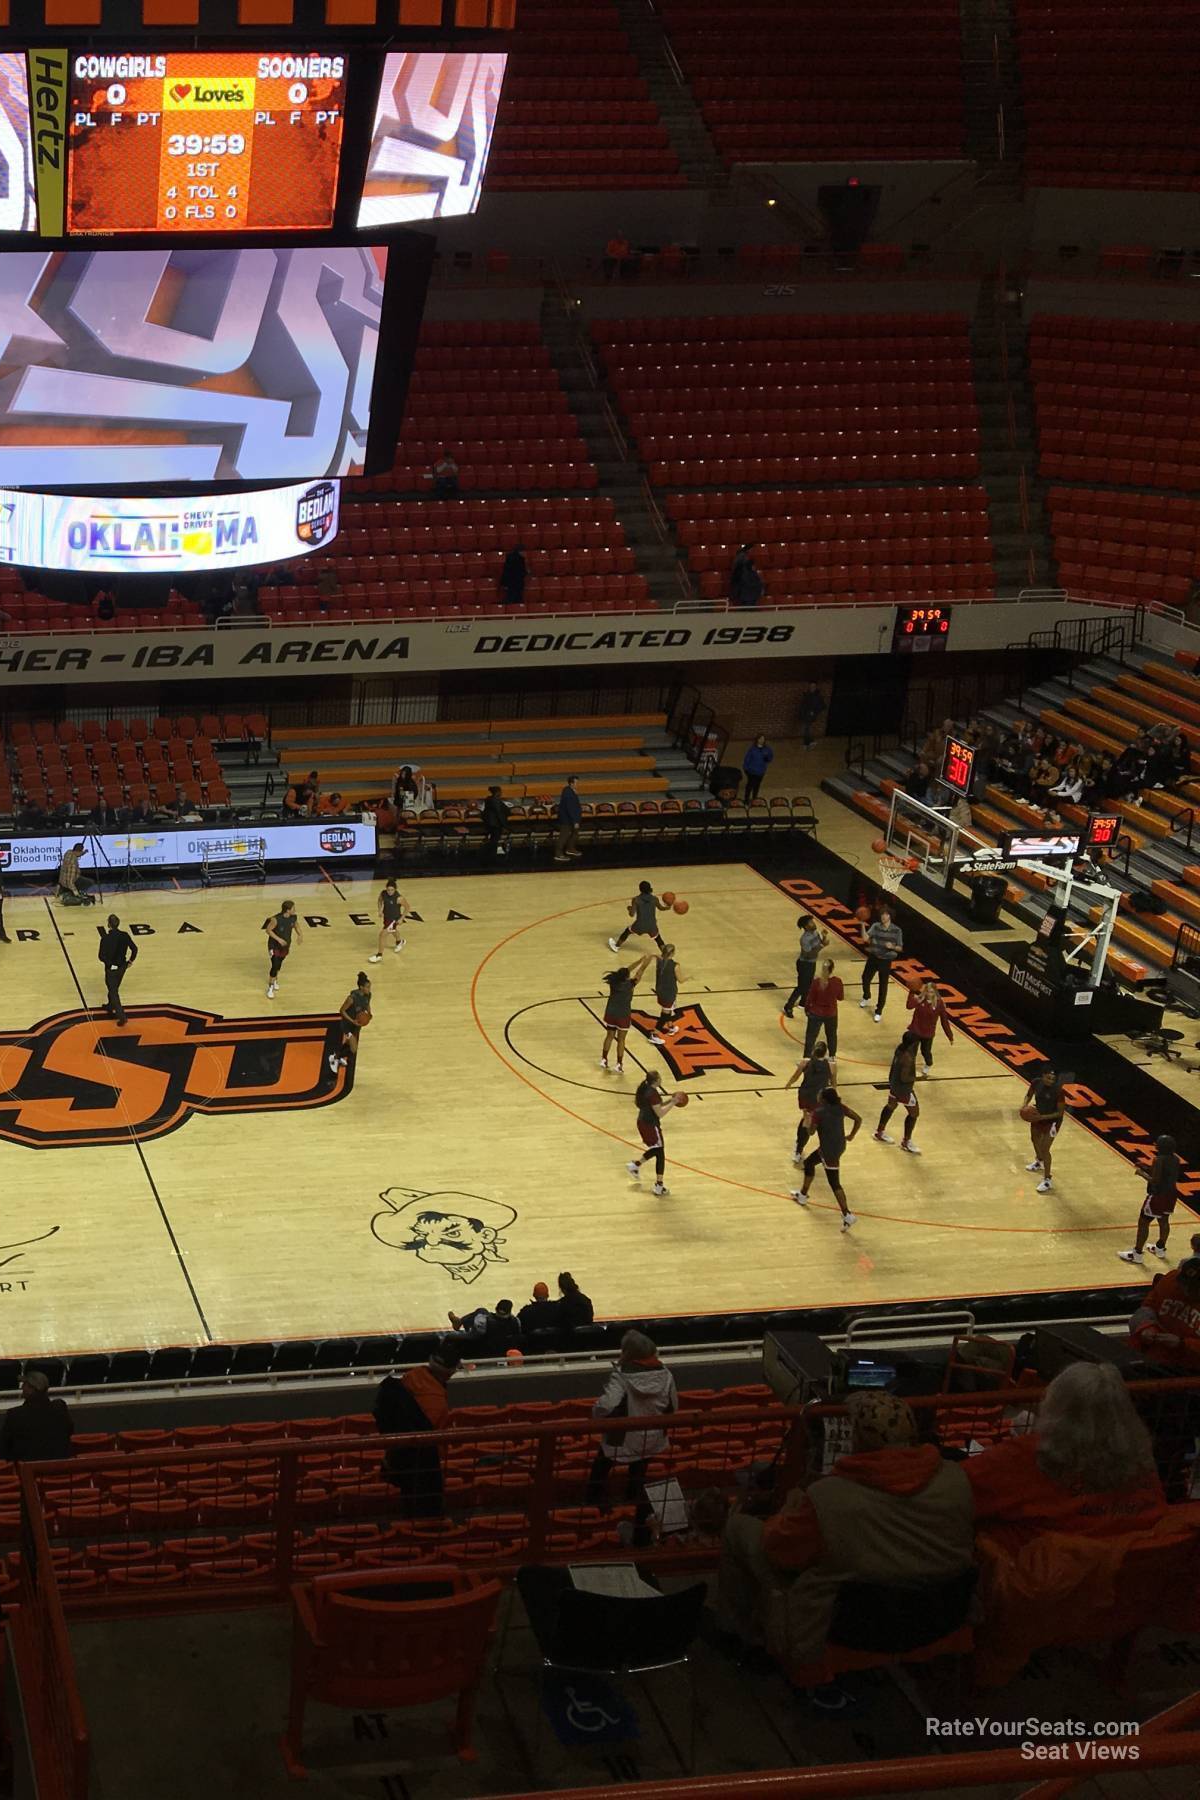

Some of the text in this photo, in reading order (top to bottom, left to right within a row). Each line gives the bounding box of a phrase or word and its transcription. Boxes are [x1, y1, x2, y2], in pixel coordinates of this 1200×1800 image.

[75, 56, 166, 79] COWGIRLS
[257, 56, 344, 78] SOONERS
[106, 84, 126, 106] 0
[288, 83, 308, 104] 0
[35, 56, 63, 169] Hertz
[75, 112, 160, 127] PL F PT
[255, 111, 339, 125] PL F PT
[167, 134, 245, 155] 39:59
[187, 163, 218, 178] 1ST
[166, 185, 238, 199] 4 TOL 4
[165, 205, 236, 219] 0 FLS 0
[184, 511, 214, 521] CHEVY
[184, 519, 214, 530] DRIVES
[238, 637, 411, 665] ARENA
[473, 628, 691, 654] DEDICATED
[702, 625, 795, 645] 1938
[321, 832, 354, 842] BEDLAM
[13, 846, 60, 855] Oklahoma
[13, 855, 41, 863] Blood
[779, 880, 1049, 1066] OKLHOMA
[352, 1713, 390, 1743] AT
